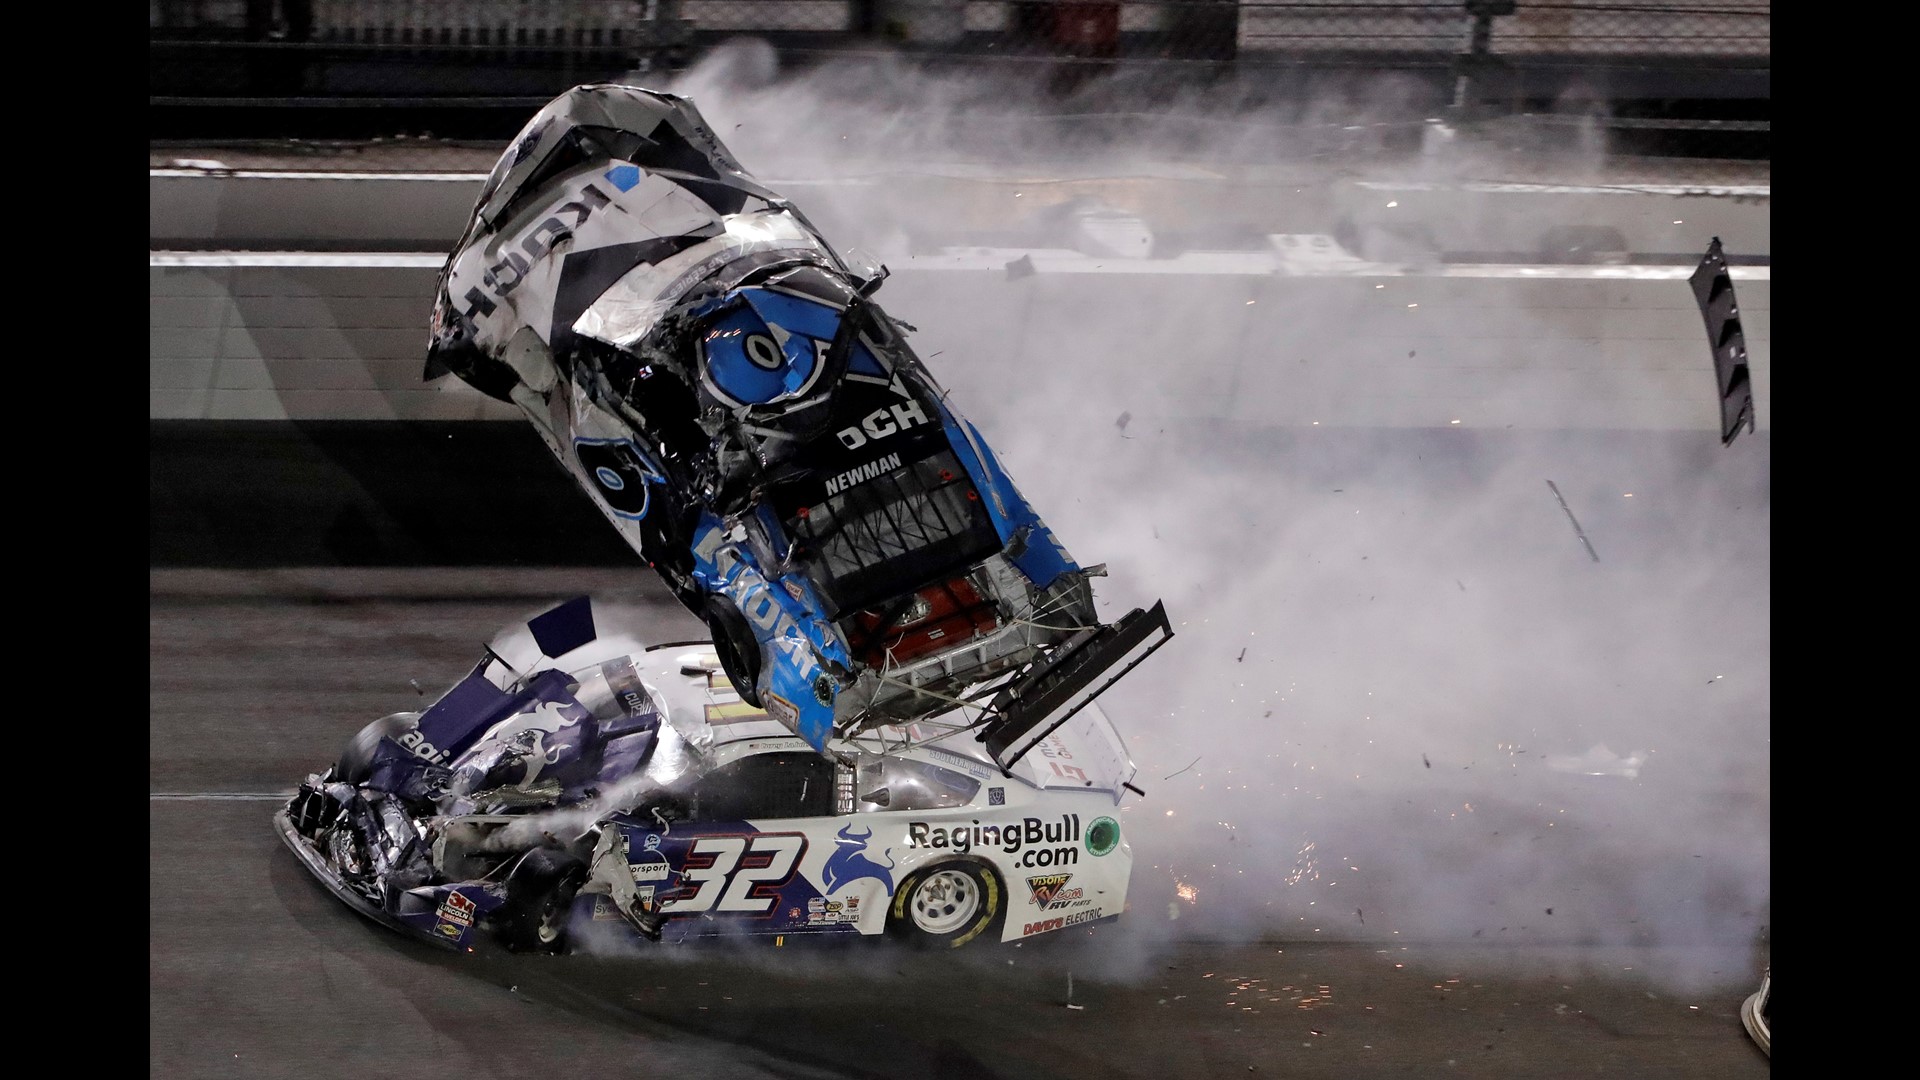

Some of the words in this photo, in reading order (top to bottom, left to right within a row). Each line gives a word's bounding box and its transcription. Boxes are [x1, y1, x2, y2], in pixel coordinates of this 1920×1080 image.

[836, 399, 929, 450] OCH
[825, 452, 902, 497] NEWMAN
[929, 750, 970, 770] SOUTHERN
[909, 814, 1080, 854] RagingBull
[1014, 846, 1079, 869] .com
[630, 864, 667, 875] orsport
[656, 834, 806, 913] 32
[440, 904, 469, 919] LINCOLN
[449, 892, 475, 914] 3M
[1048, 901, 1071, 910] RV
[1065, 907, 1103, 925] ELECTRIC
